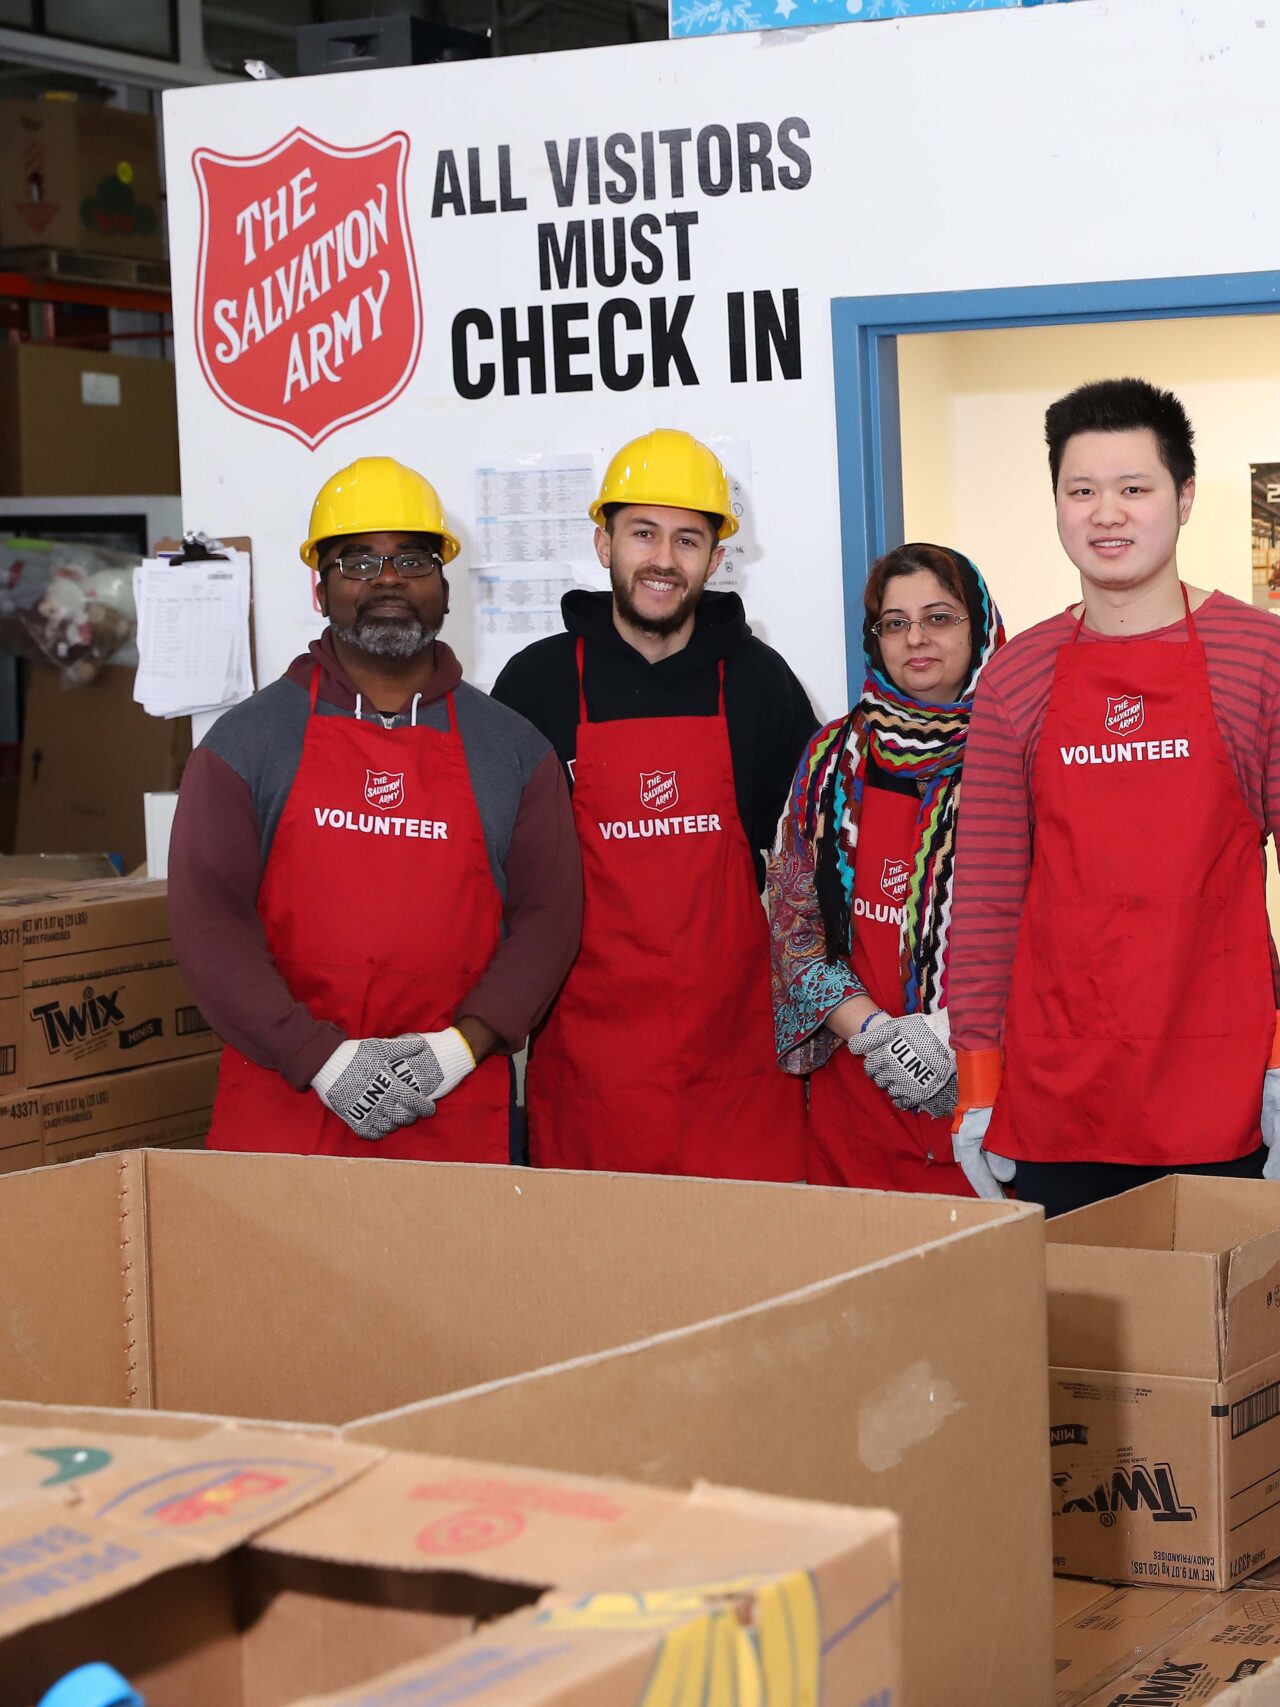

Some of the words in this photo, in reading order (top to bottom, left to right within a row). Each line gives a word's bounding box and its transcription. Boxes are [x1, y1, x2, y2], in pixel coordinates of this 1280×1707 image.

[431, 145, 527, 218] ALL
[545, 117, 812, 208] VISITORS
[236, 167, 317, 266] THE
[537, 211, 699, 290] MUST
[213, 183, 388, 364] SALVATION
[283, 269, 390, 404] ARMY
[451, 294, 700, 400] CHECK
[727, 288, 802, 383] IN
[1108, 702, 1140, 726] SALVATION
[1114, 700, 1128, 713] THE
[1119, 713, 1140, 730] ARMY
[1060, 738, 1190, 765] VOLUNTEER
[367, 779, 400, 798] SALVATION
[373, 776, 387, 785] THE
[643, 777, 673, 802] SALVATION
[647, 775, 661, 788] THE
[379, 790, 399, 804] ARMY
[655, 789, 673, 807] ARMY
[314, 807, 448, 840] VOLUNTEER
[599, 814, 721, 840] VOLUNTEER
[883, 872, 909, 888] SALVATI
[889, 865, 903, 876] THE
[893, 883, 907, 895] ARM
[128, 1023, 154, 1044] MINIS
[891, 1038, 934, 1086] ULINE
[388, 1058, 420, 1094] LIN
[348, 1073, 391, 1121] ULINE
[1051, 1429, 1075, 1441] MIN
[1153, 1551, 1215, 1566] CANDY/FRIANDISES
[1161, 1563, 1170, 1577] kg
[1172, 1566, 1187, 1577] 9.07
[1188, 1568, 1200, 1580] WT
[1201, 1569, 1215, 1582] NET
